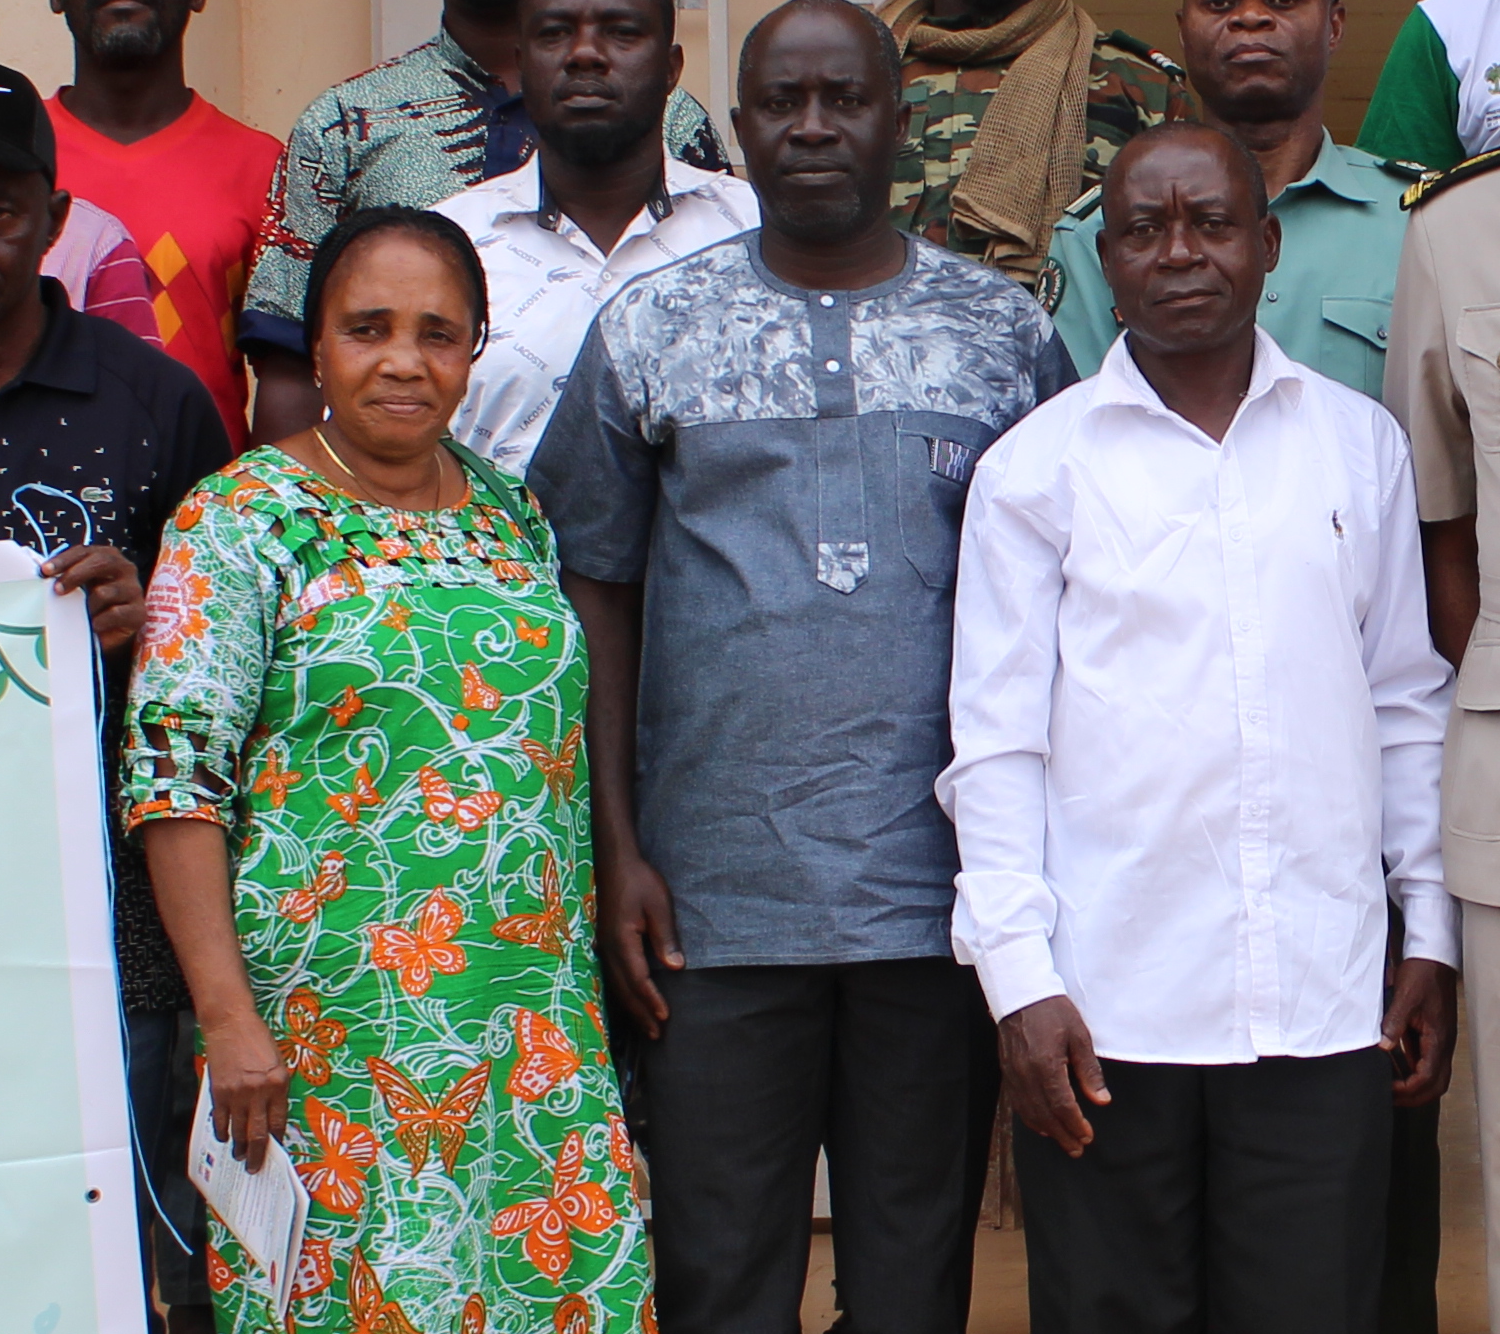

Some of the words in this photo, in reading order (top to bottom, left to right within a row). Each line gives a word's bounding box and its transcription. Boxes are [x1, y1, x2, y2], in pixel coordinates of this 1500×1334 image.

[506, 243, 543, 268] LACOSTE
[514, 286, 548, 318] LACOSTE
[512, 342, 549, 373] LACOSTE
[519, 397, 552, 432] LACOSTE
